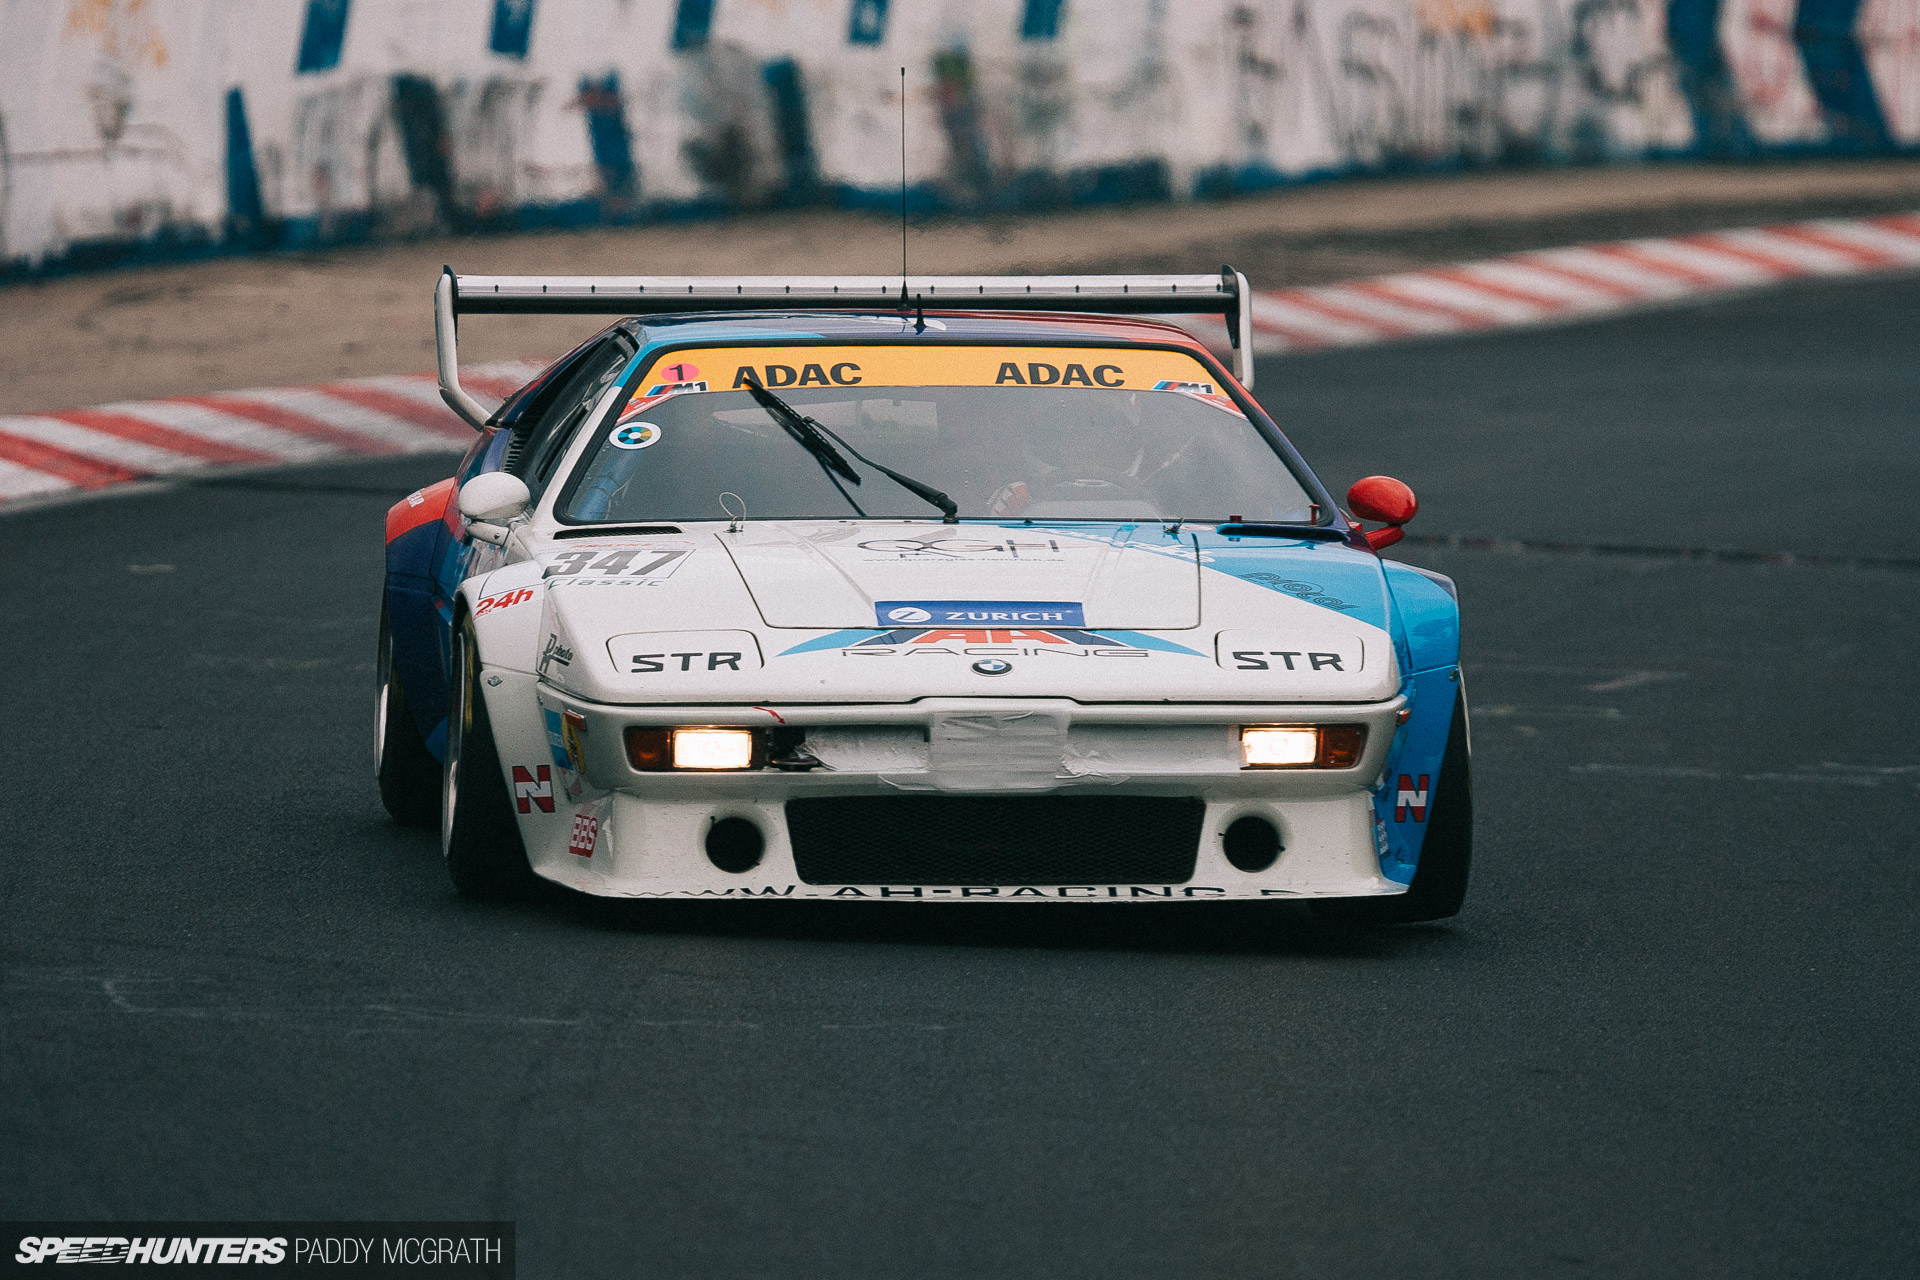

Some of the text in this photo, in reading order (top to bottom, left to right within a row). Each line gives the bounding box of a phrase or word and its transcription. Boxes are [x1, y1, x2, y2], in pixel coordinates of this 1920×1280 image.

[668, 364, 685, 381] 1
[732, 363, 862, 389] ADAC
[995, 362, 1125, 388] ADAC
[542, 550, 688, 579] 347
[475, 588, 534, 617] 24h
[946, 611, 1064, 622] ZURICH
[631, 652, 742, 673] STR
[842, 648, 1149, 658] RACING
[1232, 651, 1345, 671] STR
